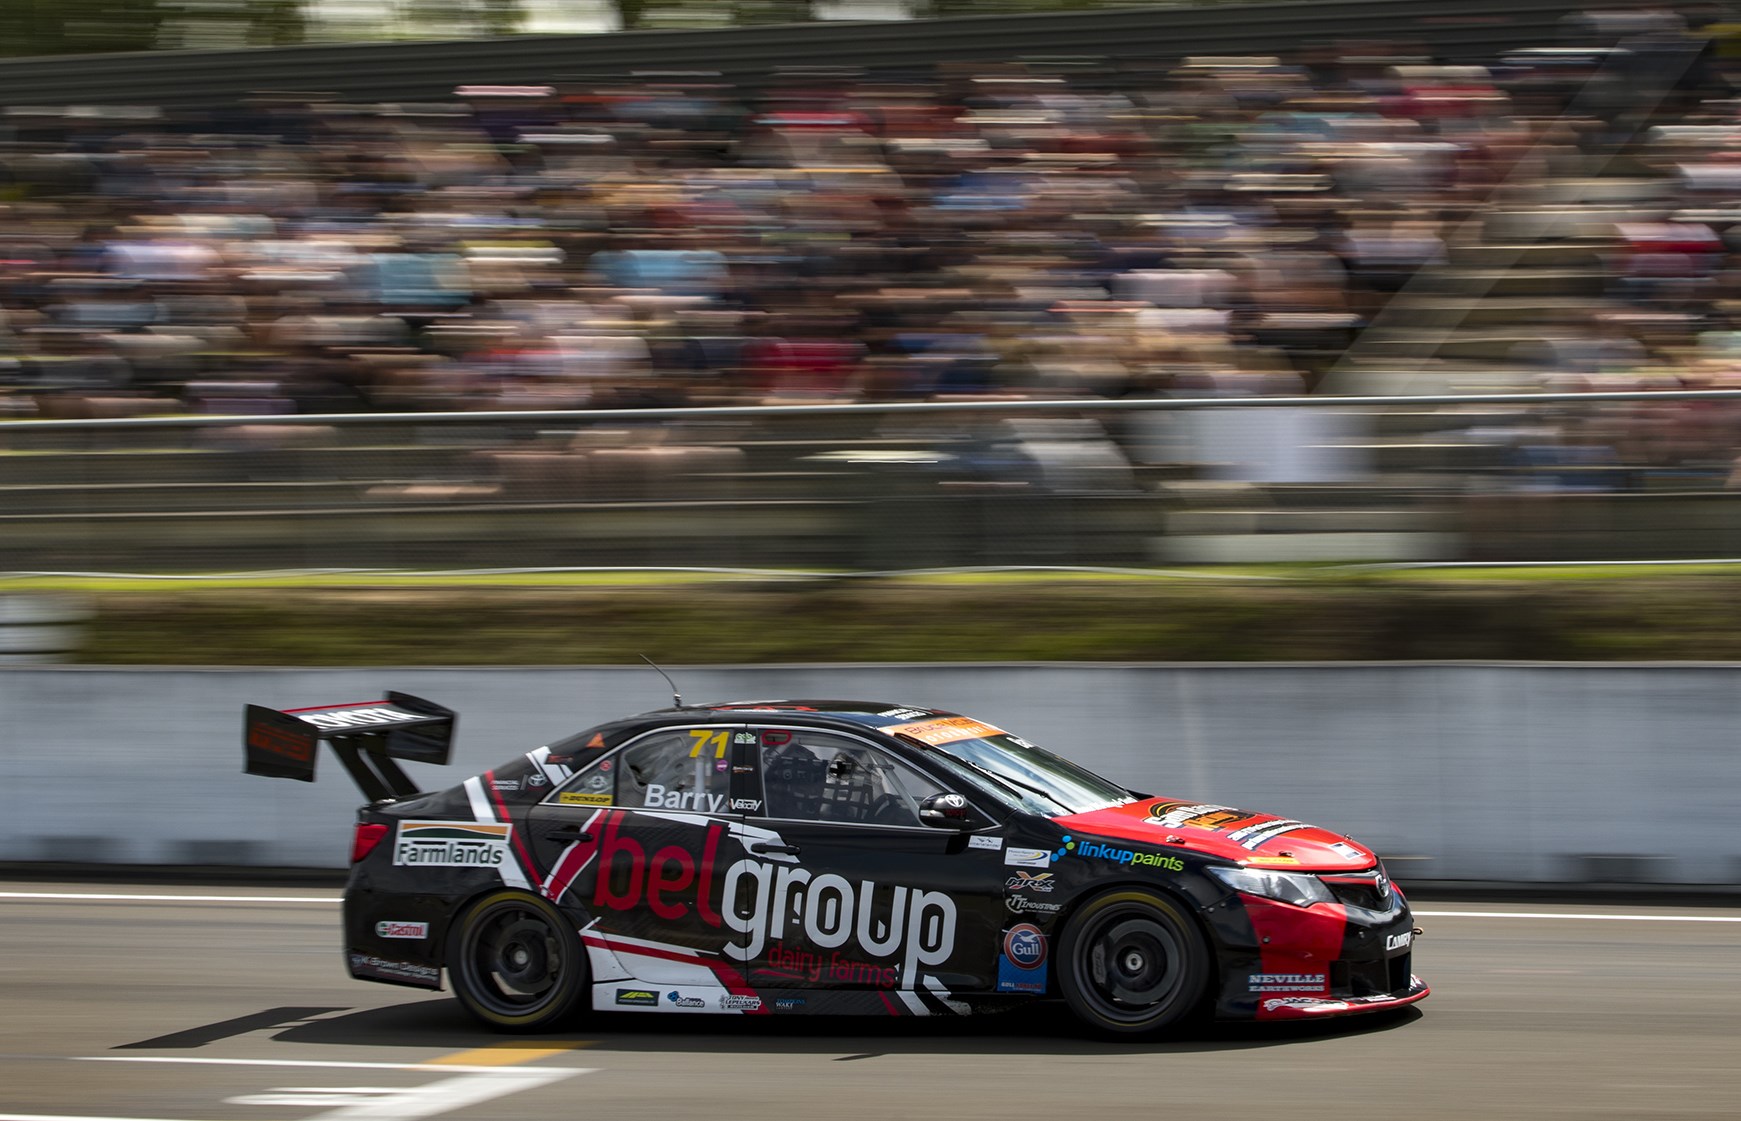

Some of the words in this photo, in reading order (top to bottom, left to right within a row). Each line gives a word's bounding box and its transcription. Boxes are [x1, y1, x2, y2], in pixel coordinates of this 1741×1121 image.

[297, 707, 428, 729] OYOTA
[688, 729, 730, 758] 71
[568, 795, 610, 803] DUNLOP
[643, 783, 724, 813] Barry
[397, 842, 504, 866] Farmlands
[1012, 942, 1040, 956] Gull
[767, 941, 823, 982] dairy
[829, 951, 897, 988] farms
[1248, 974, 1326, 983] NEVILLE
